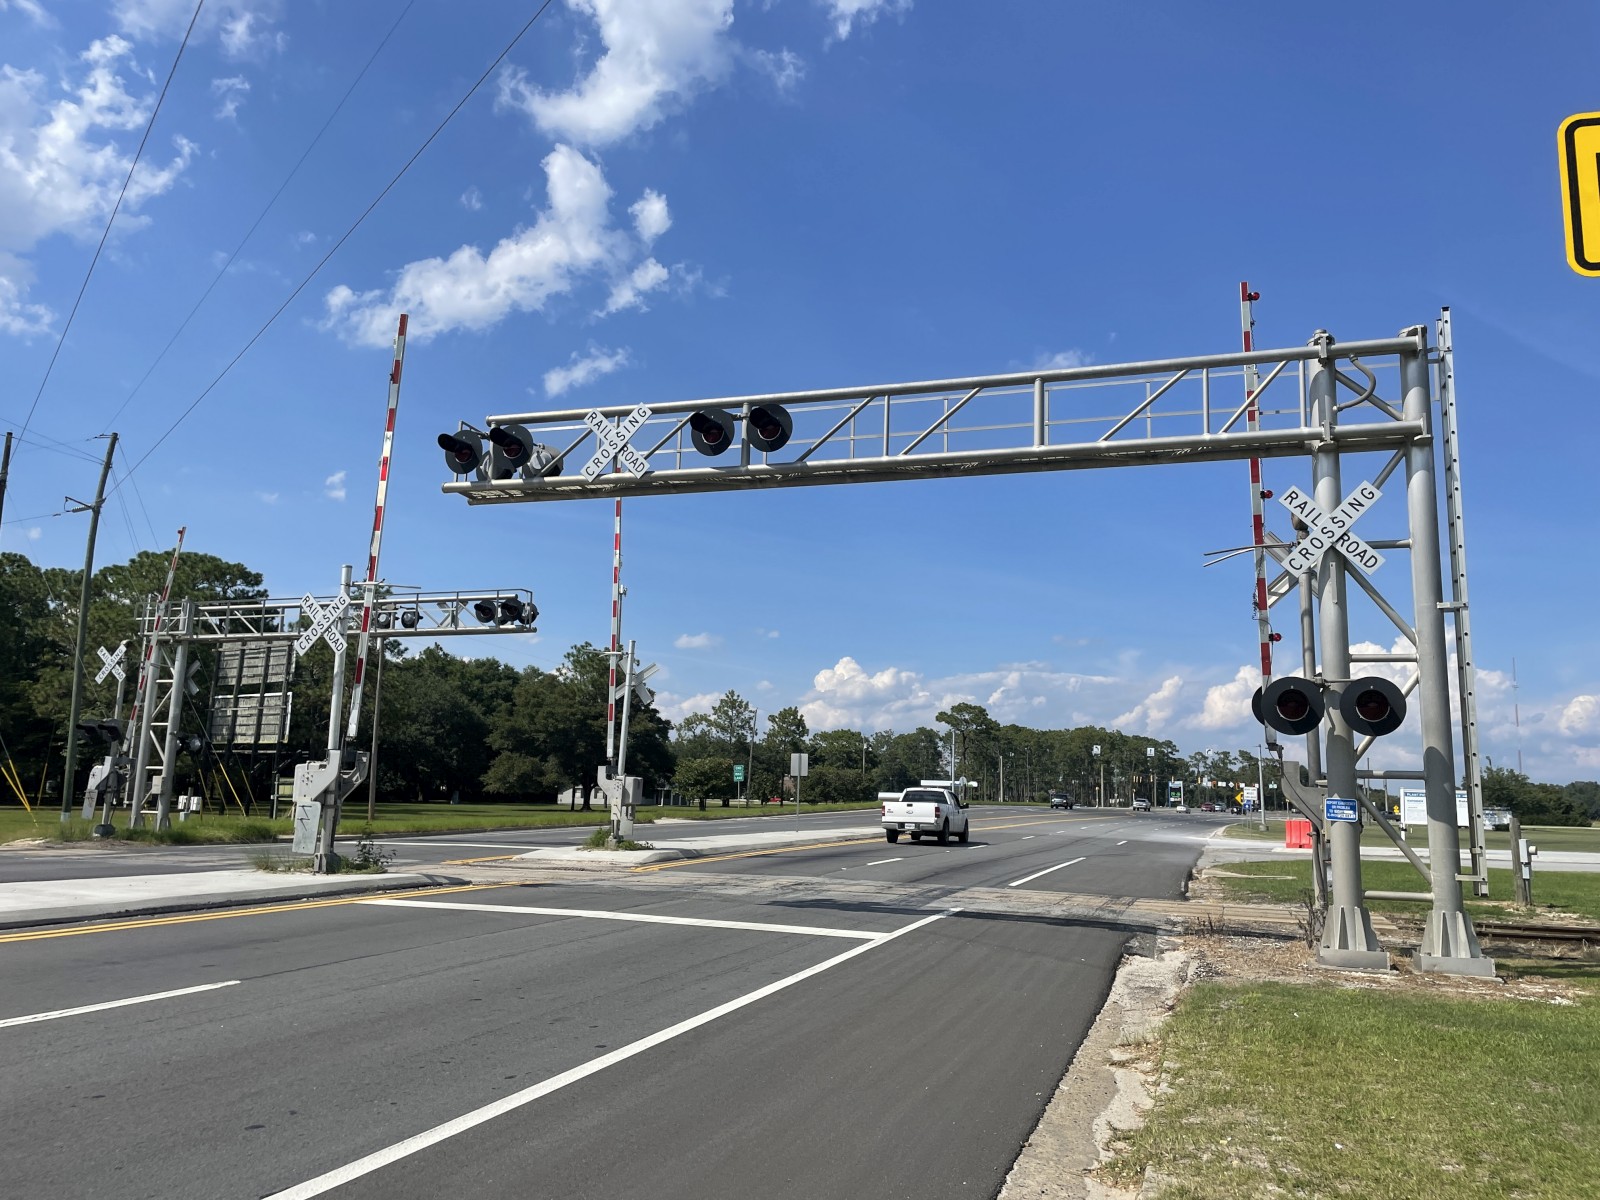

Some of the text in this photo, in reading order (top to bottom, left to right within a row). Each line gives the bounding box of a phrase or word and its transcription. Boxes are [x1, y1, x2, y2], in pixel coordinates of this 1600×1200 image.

[585, 407, 647, 477] CROSSING
[587, 411, 612, 441] RAIL
[620, 444, 645, 473] ROAD
[1283, 490, 1322, 527] RAIL
[1288, 487, 1375, 571] CROSSING
[1335, 532, 1378, 569] ROAD
[299, 596, 346, 650] CROSSING
[302, 595, 320, 620] RAIL
[99, 648, 110, 662] RAIL
[324, 626, 344, 652] ROAD
[98, 648, 123, 680] CROSSING
